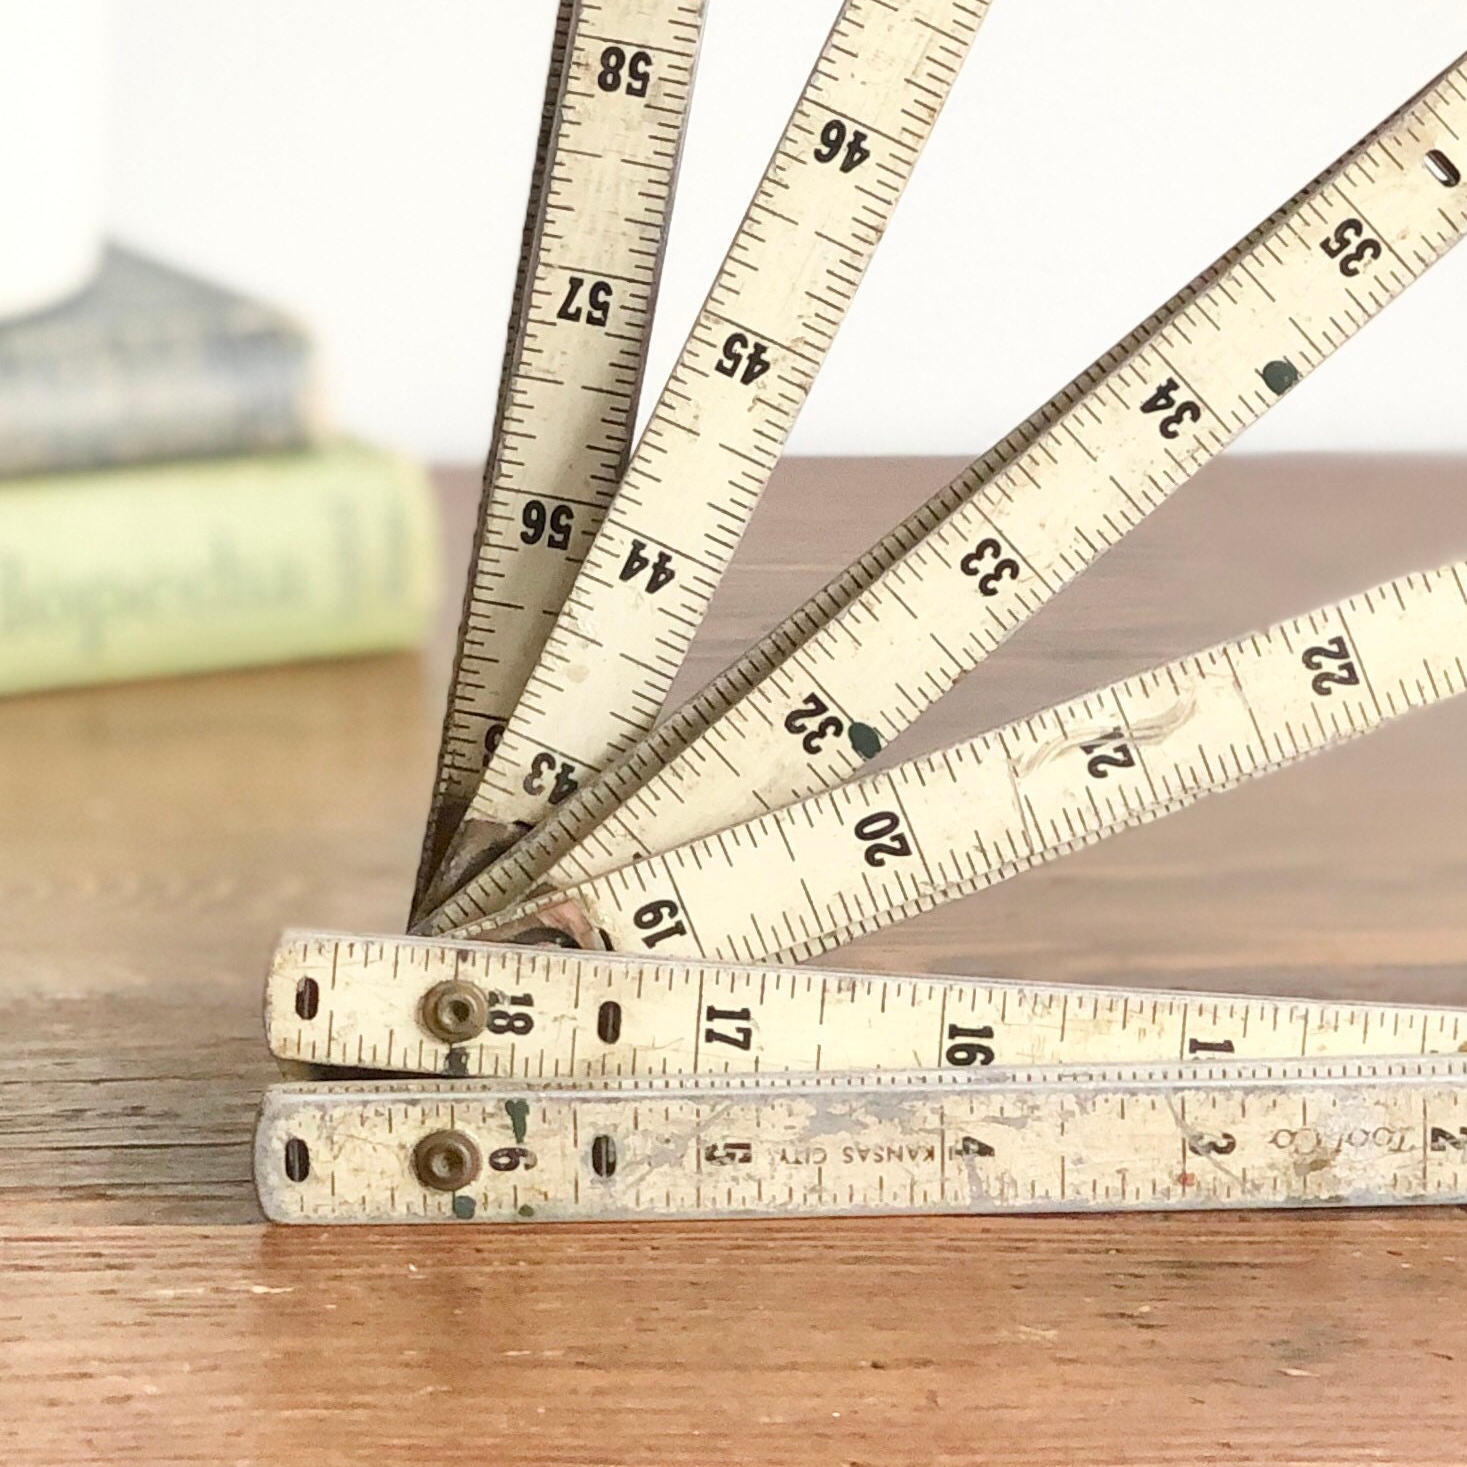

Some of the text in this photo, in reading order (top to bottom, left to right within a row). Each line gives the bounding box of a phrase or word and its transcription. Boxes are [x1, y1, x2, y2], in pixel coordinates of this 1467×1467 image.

[597, 46, 653, 98] 58
[813, 120, 870, 173] 46
[1319, 218, 1382, 277] 35
[557, 277, 613, 327] 57
[715, 333, 771, 386] 45
[1139, 377, 1201, 439] 34
[520, 500, 575, 550] 56
[619, 539, 676, 594] 44
[960, 537, 1020, 596] 33
[1302, 636, 1360, 696] 22
[784, 692, 844, 755] 32
[523, 752, 579, 805] 43
[1082, 726, 1135, 780] 21
[854, 810, 911, 867] 20
[632, 899, 687, 948] 19
[487, 990, 535, 1036] 18
[704, 1004, 752, 1052] 17
[946, 1023, 995, 1067] 16
[1188, 1038, 1235, 1061] 1
[488, 1146, 538, 1173] 6
[842, 1144, 935, 1163] KANSAS
[1188, 1132, 1237, 1156] 3
